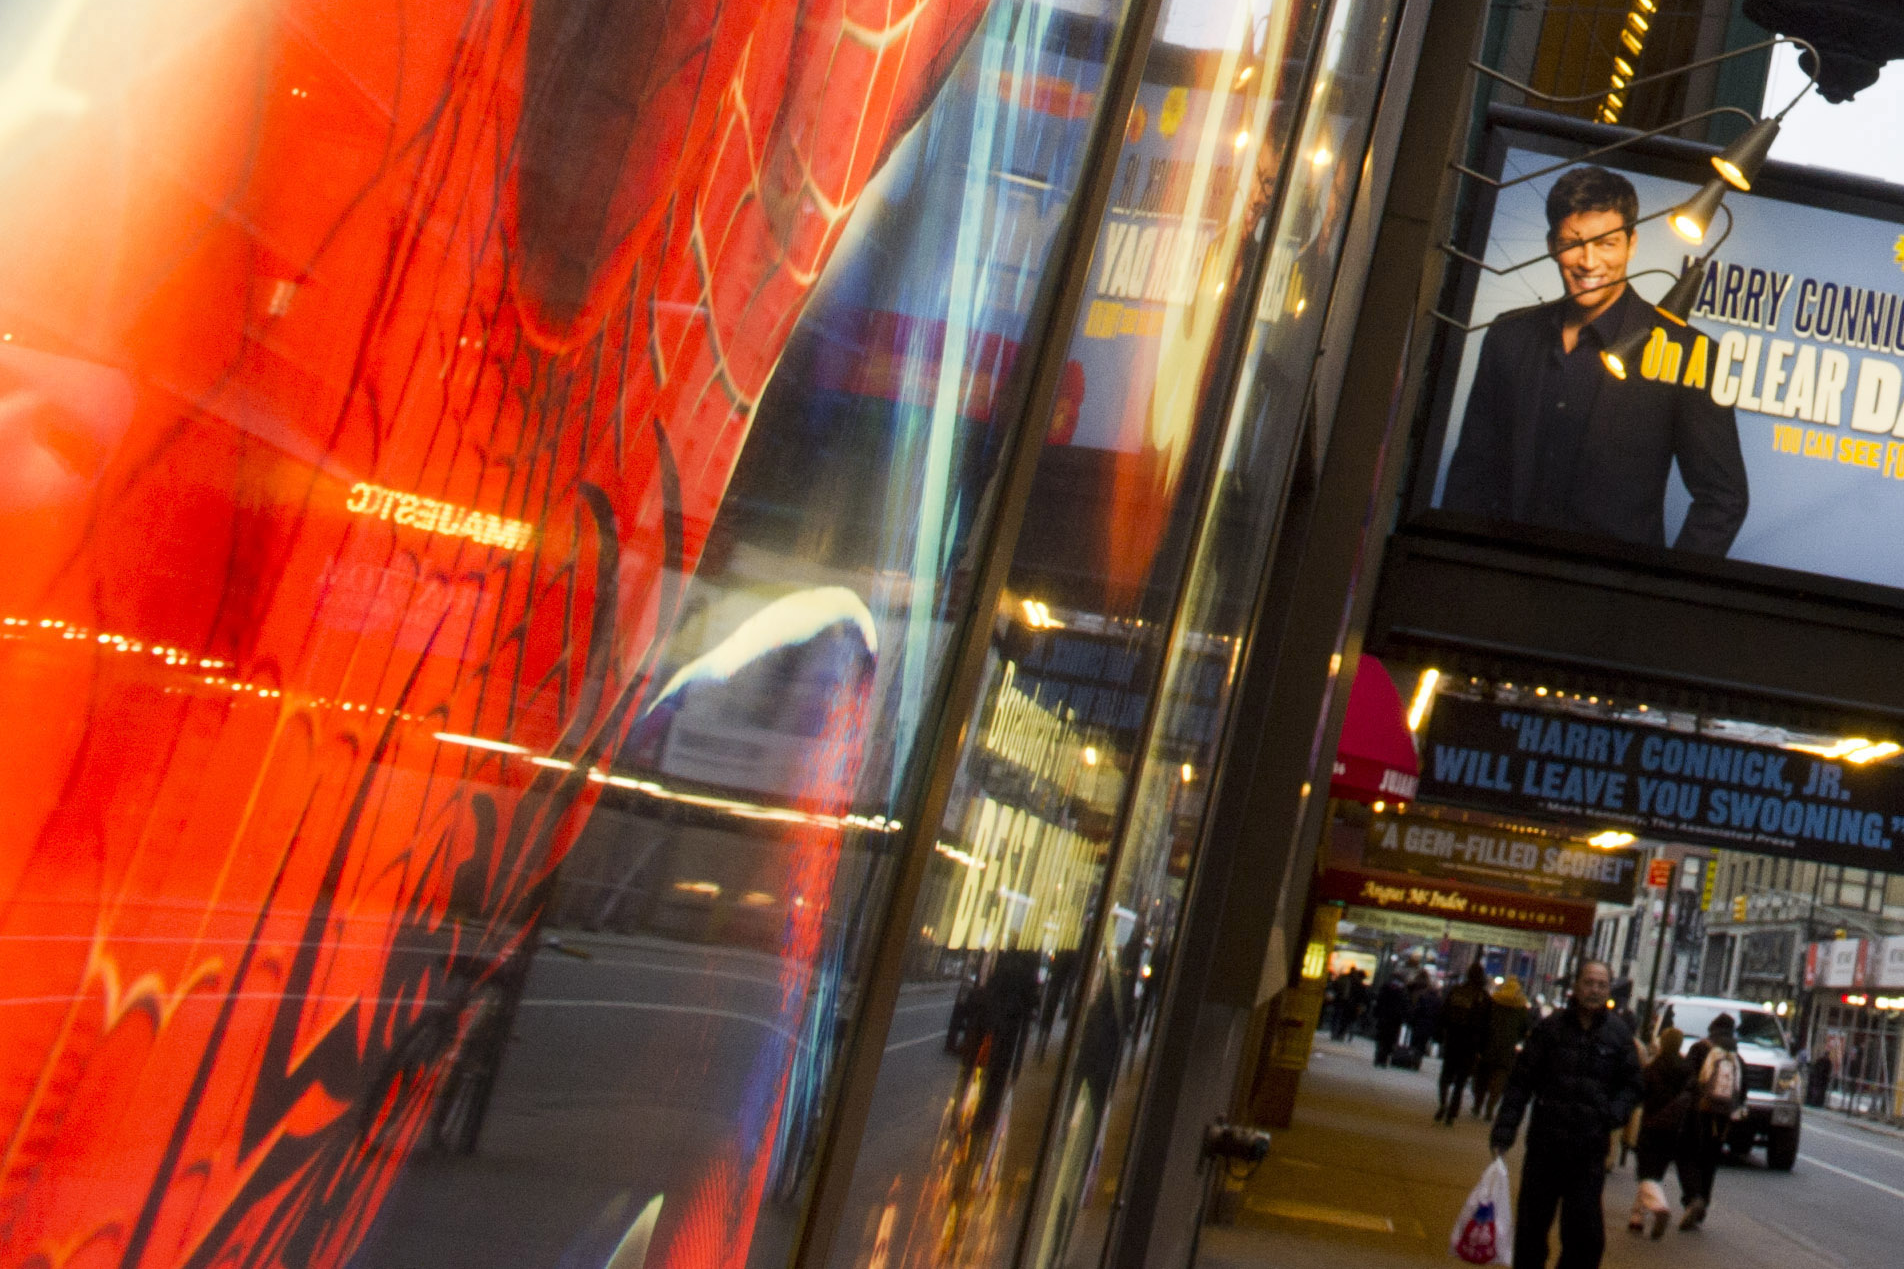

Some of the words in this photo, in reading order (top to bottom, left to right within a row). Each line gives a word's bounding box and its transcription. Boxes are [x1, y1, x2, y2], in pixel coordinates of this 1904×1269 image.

[1640, 326, 1683, 384] On
[1683, 335, 1709, 389] A
[1711, 331, 1850, 427] CLEAR
[1773, 424, 1801, 455] YOU
[1804, 430, 1836, 460] CAN
[1838, 438, 1883, 469] SEE
[1434, 744, 1512, 792] WILL
[1522, 759, 1628, 809] LEAVE
[1638, 775, 1701, 820] YOU
[1500, 711, 1634, 765] "HARRY
[1641, 735, 1793, 797] CONNICK,
[1803, 761, 1851, 802] JR.
[1404, 826, 1540, 871] GEM-FILLED
